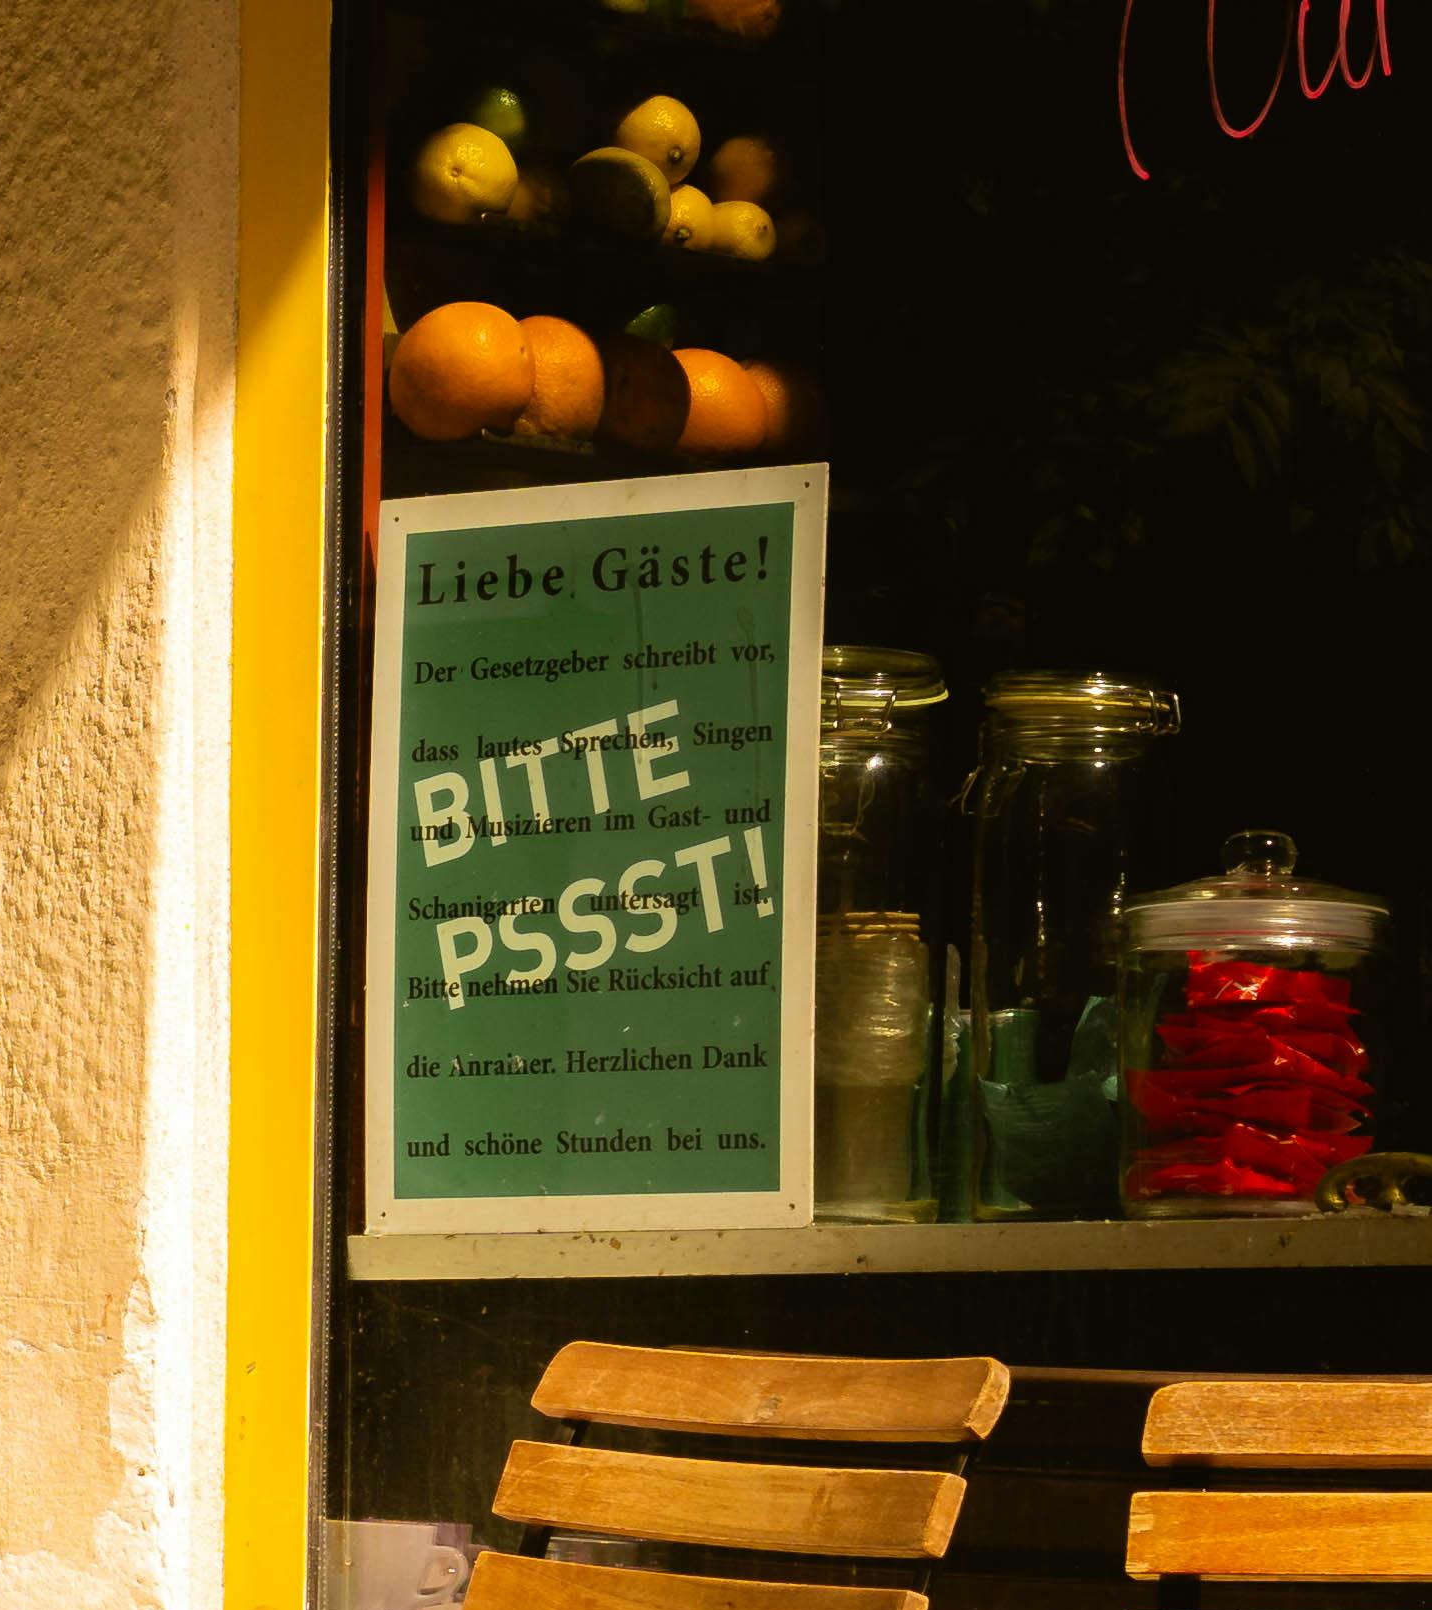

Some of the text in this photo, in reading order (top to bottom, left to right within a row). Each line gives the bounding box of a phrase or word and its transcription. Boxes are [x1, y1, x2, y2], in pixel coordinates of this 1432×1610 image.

[417, 535, 770, 606] Liebe Gäste!
[414, 640, 776, 686] Der Gesetzgeber schreibt vor,
[411, 720, 774, 764] dass lautes Sprechen, Singen
[413, 699, 691, 868] BITTE
[410, 798, 771, 842] und Musizieren im Gast- und
[407, 882, 769, 924] Schanigarten untersagt ist.
[436, 825, 776, 1011] PSSST!
[406, 960, 770, 1002] Bitte nehmen Sie Rücksicht auf
[405, 1043, 768, 1080] die Anrainer. Herzlichen Dank
[406, 1126, 767, 1159] und schöne Stunden bei uns.
